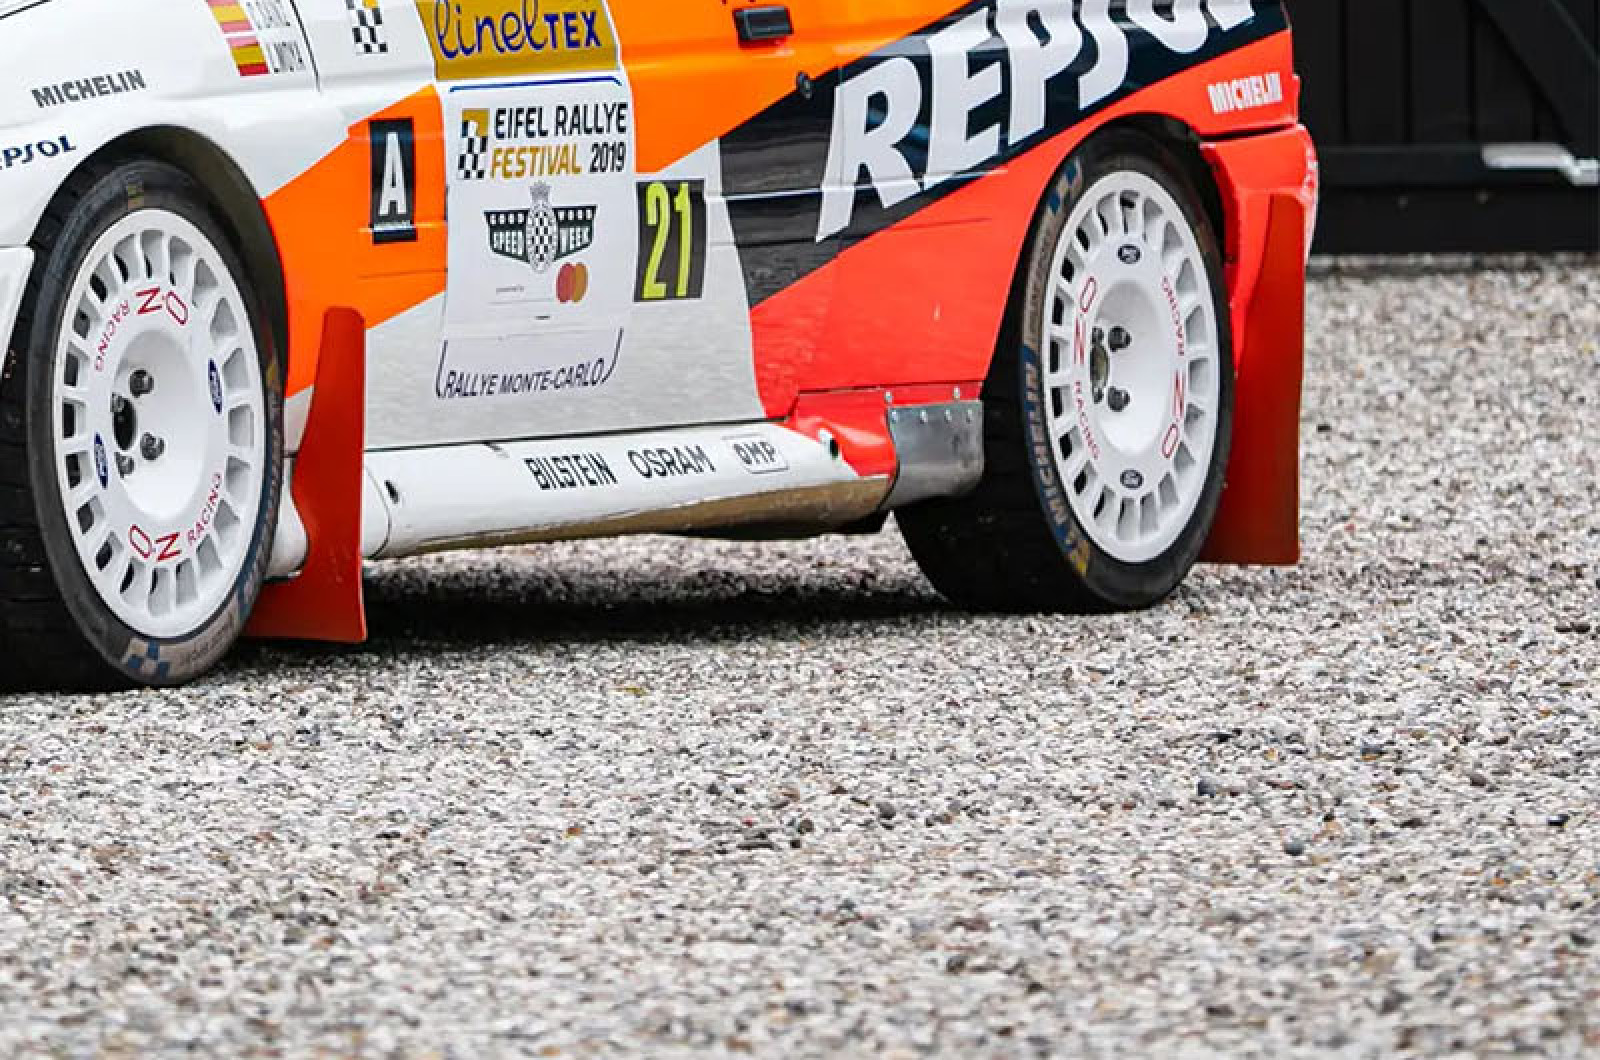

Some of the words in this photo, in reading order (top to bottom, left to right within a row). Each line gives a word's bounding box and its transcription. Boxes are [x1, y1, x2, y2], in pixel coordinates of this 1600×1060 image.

[31, 69, 147, 109] MICHELIN
[1207, 72, 1283, 115] MICHELIN
[495, 107, 549, 139] EIFEL
[554, 102, 629, 137] RALLYE
[378, 131, 407, 215] A
[490, 143, 583, 179] FESTIVAL
[589, 141, 628, 174] 2019
[642, 181, 691, 299] 21
[443, 365, 499, 399] RALLYE
[499, 357, 604, 394] MONTE-CARLO
[523, 451, 619, 491] BILSTEIN
[626, 443, 717, 480] OSRAM
[733, 438, 779, 468] OMP
